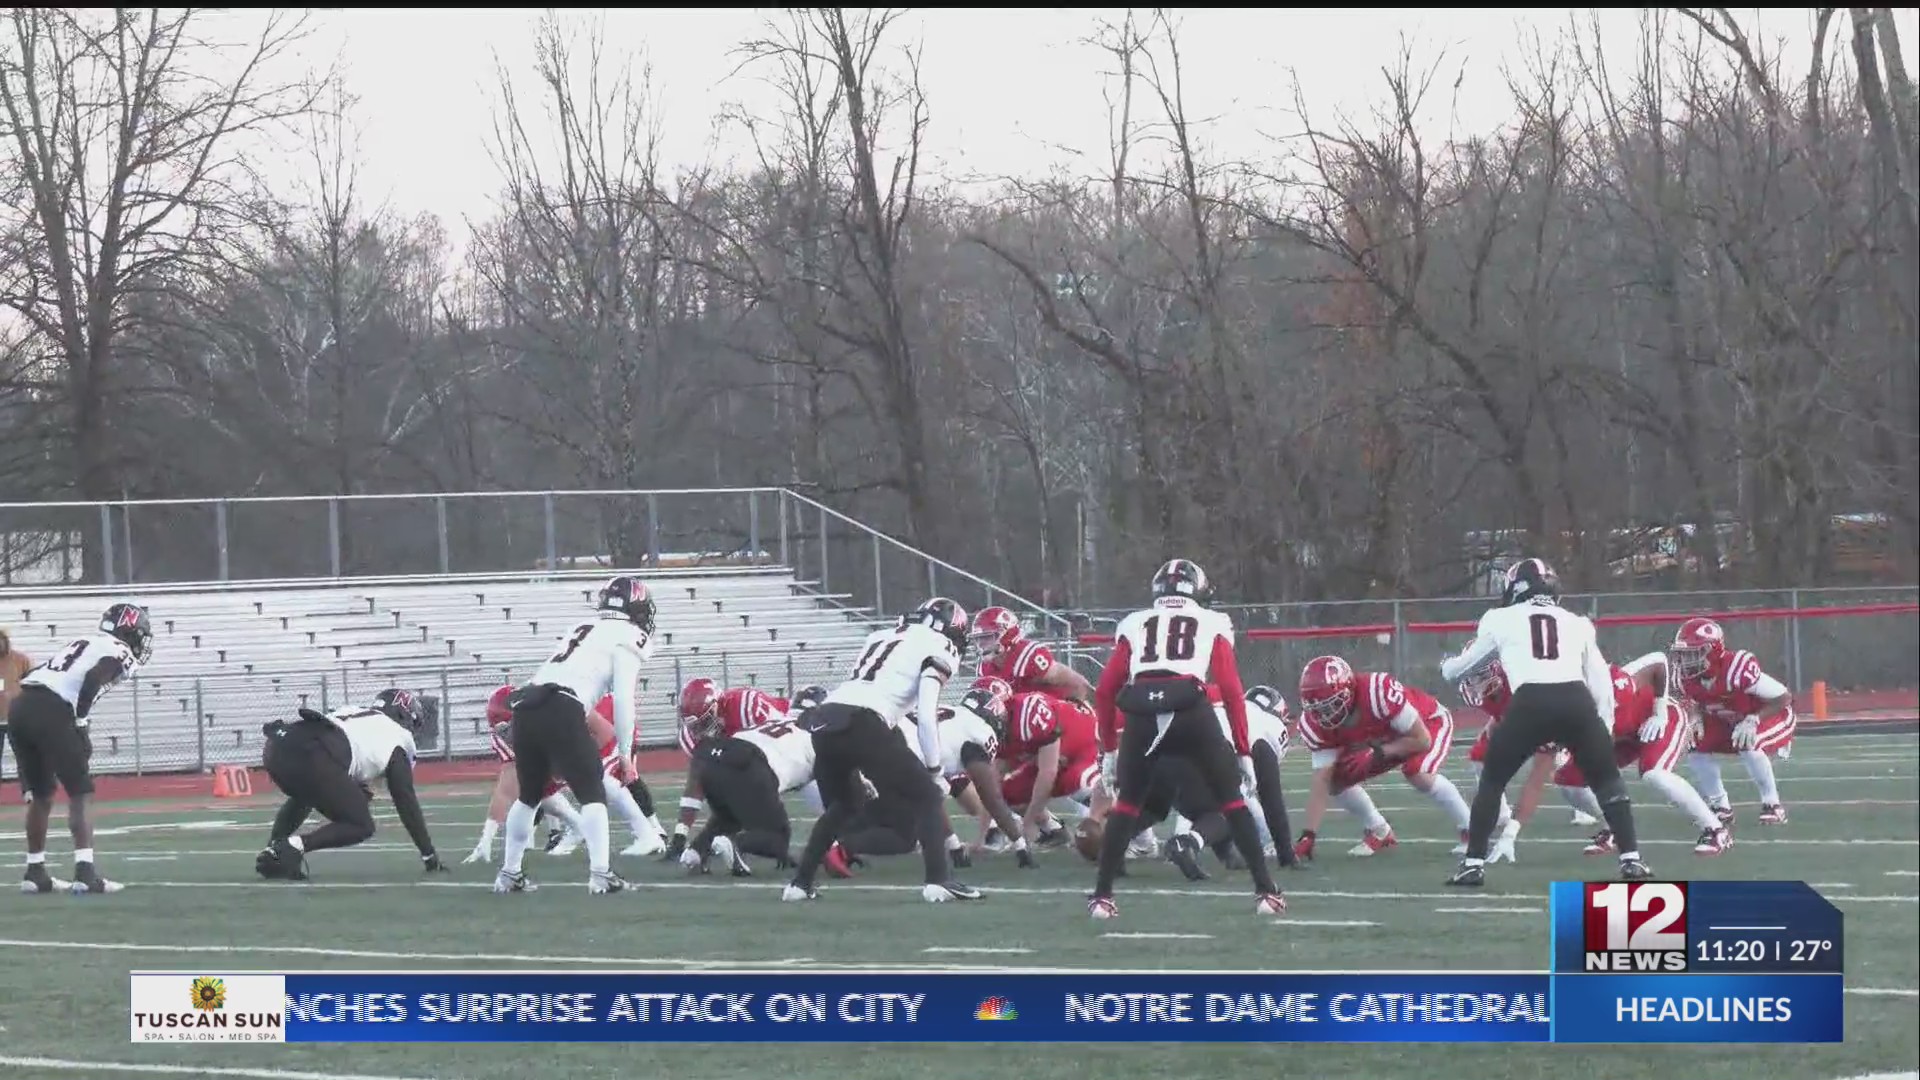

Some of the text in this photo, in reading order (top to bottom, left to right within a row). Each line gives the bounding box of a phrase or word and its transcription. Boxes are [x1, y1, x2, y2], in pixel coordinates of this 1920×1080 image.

[550, 625, 595, 663] 3
[636, 633, 648, 649] 3
[1140, 615, 1198, 663] 18
[1529, 613, 1560, 660] 0
[852, 639, 904, 681] 11
[1035, 655, 1049, 670] 8
[1744, 663, 1760, 684] 12
[1032, 698, 1051, 731] 73
[224, 769, 248, 794] 10
